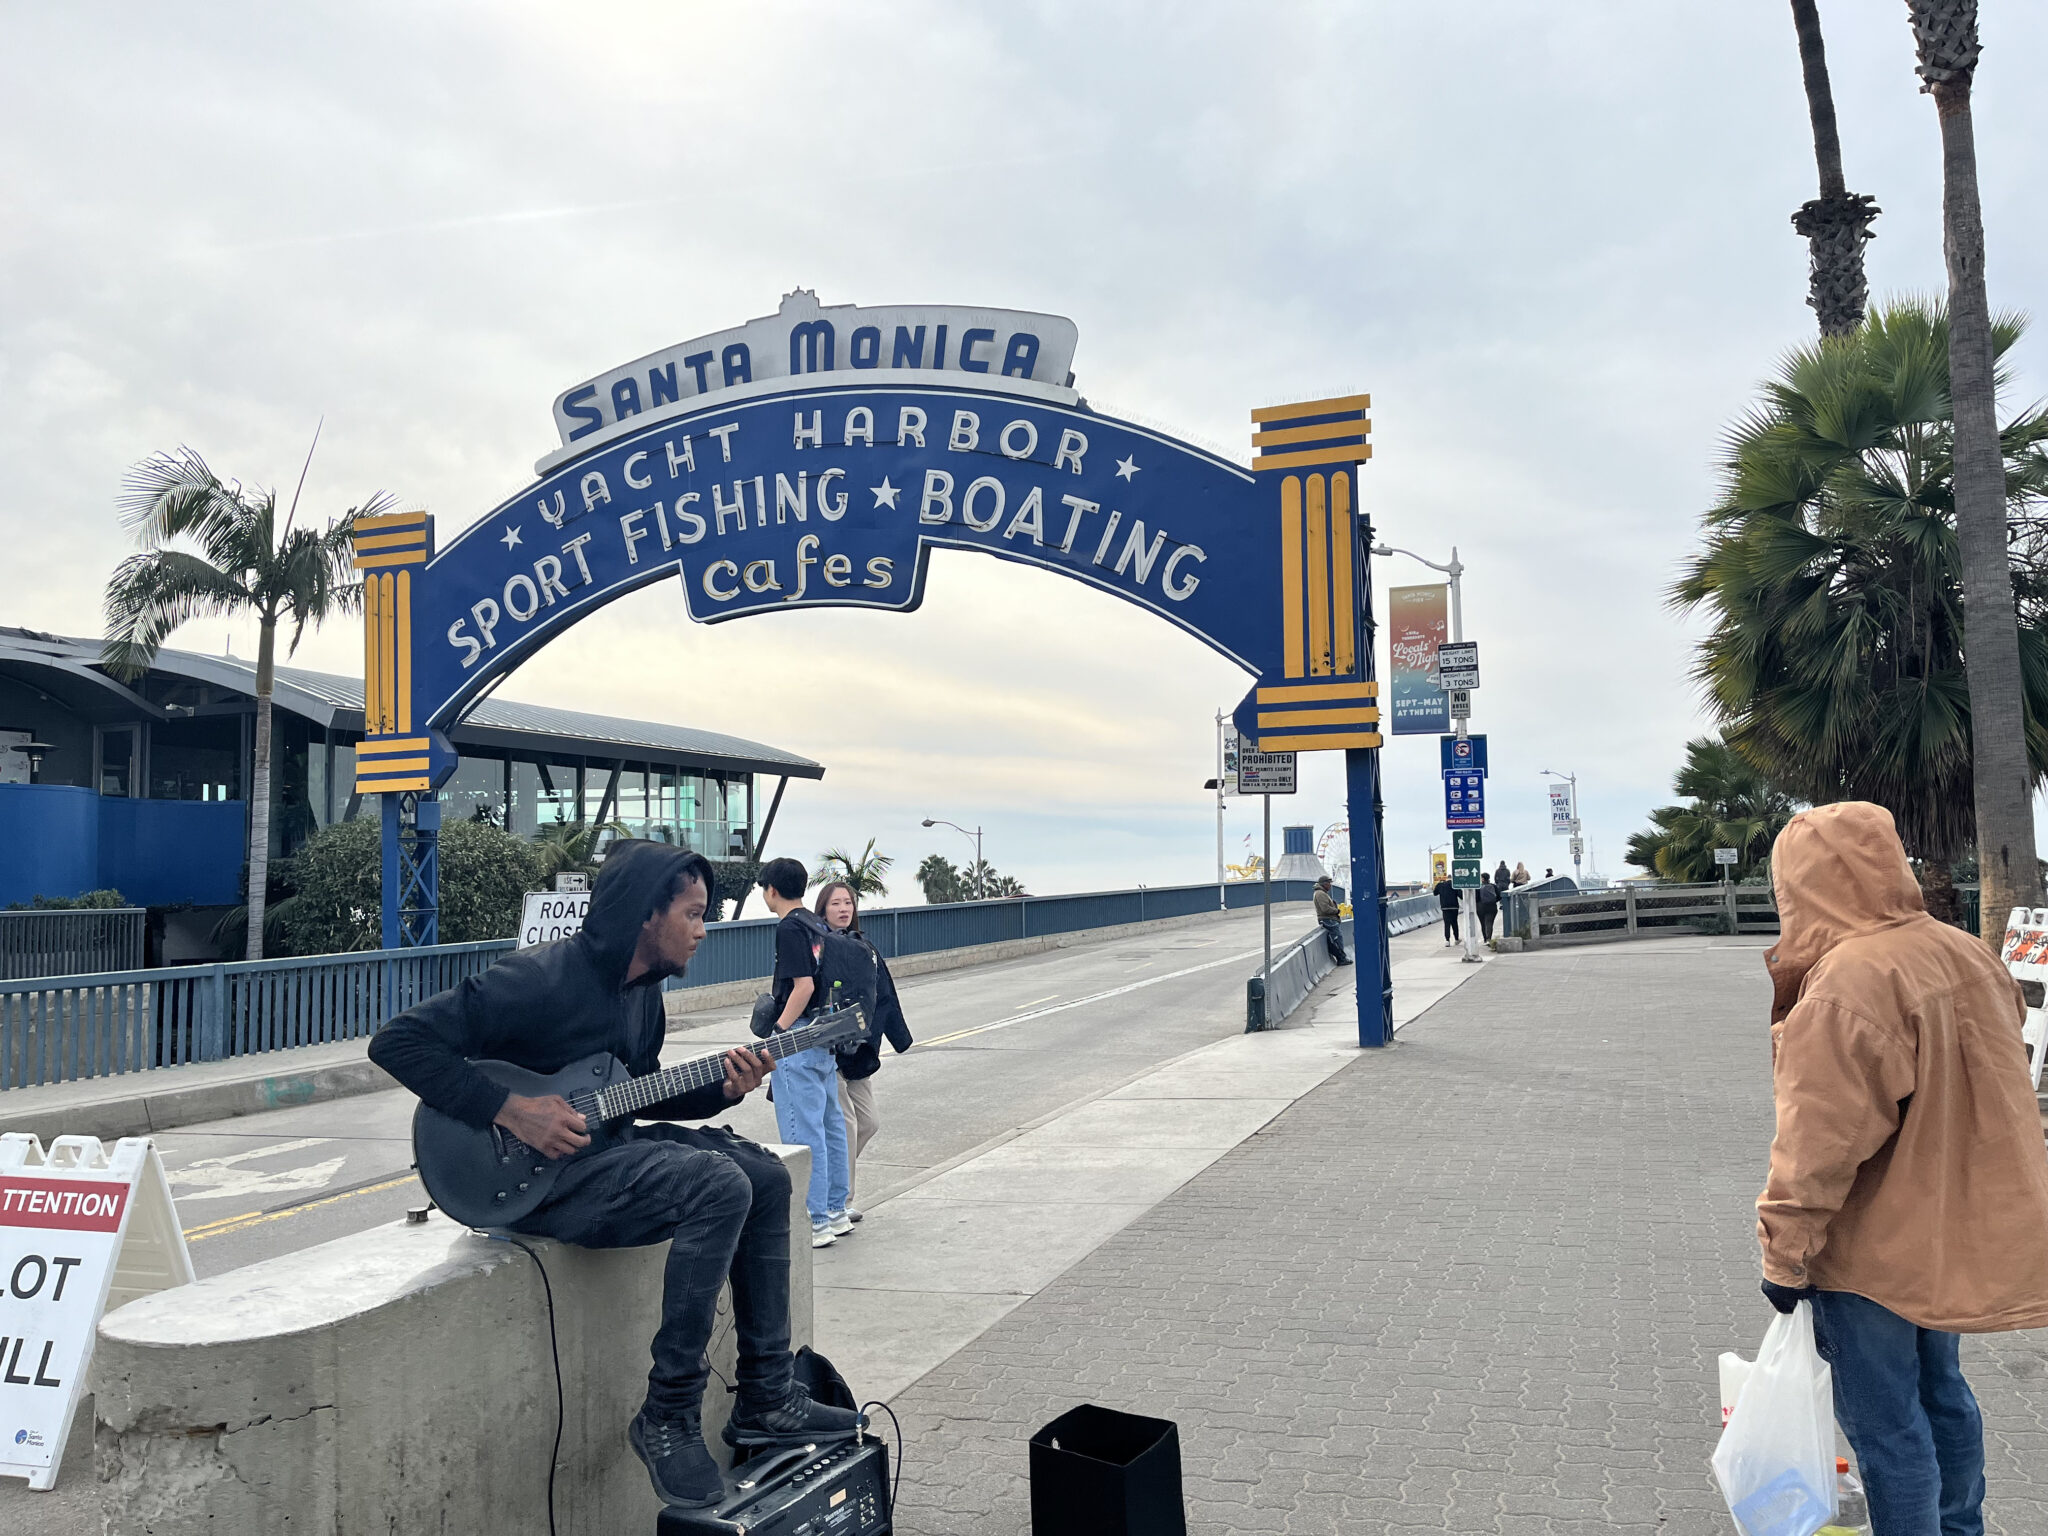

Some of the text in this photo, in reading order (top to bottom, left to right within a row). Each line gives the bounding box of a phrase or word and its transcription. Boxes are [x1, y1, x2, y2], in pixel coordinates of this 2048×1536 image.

[562, 319, 1040, 443] SANTA MONICA
[537, 405, 1089, 529] YACHT HARBOR
[447, 467, 1208, 668] SPORT FISHING BOATING
[703, 535, 896, 601] cafes
[1407, 651, 1439, 670] Nigh
[1453, 656, 1474, 664] TONS
[1454, 692, 1467, 702] NO
[1409, 708, 1424, 716] THE
[1425, 707, 1443, 715] PIER
[1242, 754, 1292, 764] PROHIBITED
[1552, 798, 1569, 806] SAVE
[1553, 812, 1570, 821] PIER
[540, 901, 590, 919] ROAD
[526, 926, 582, 945] CLOS
[2, 1188, 119, 1218] TTENTION
[0, 1254, 82, 1301] OT
